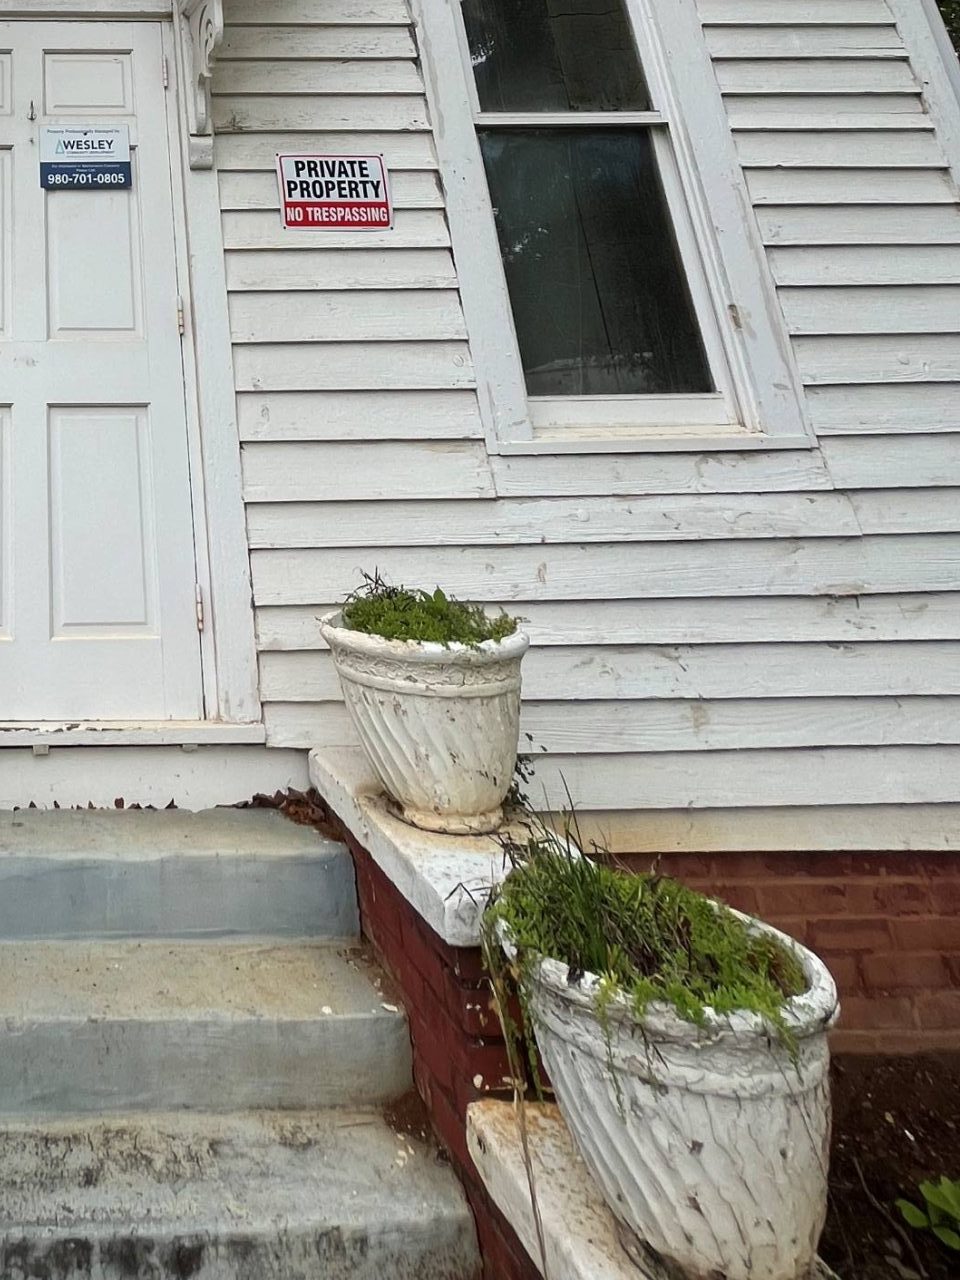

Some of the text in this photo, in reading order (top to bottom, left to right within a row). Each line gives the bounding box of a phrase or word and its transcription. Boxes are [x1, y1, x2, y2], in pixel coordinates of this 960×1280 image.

[63, 139, 114, 150] WESLEY
[294, 160, 370, 178] PRIVATE
[47, 173, 125, 184] 980-701-0805
[286, 180, 381, 199] PROPERTY
[286, 207, 388, 222] NO TRESPASSING
